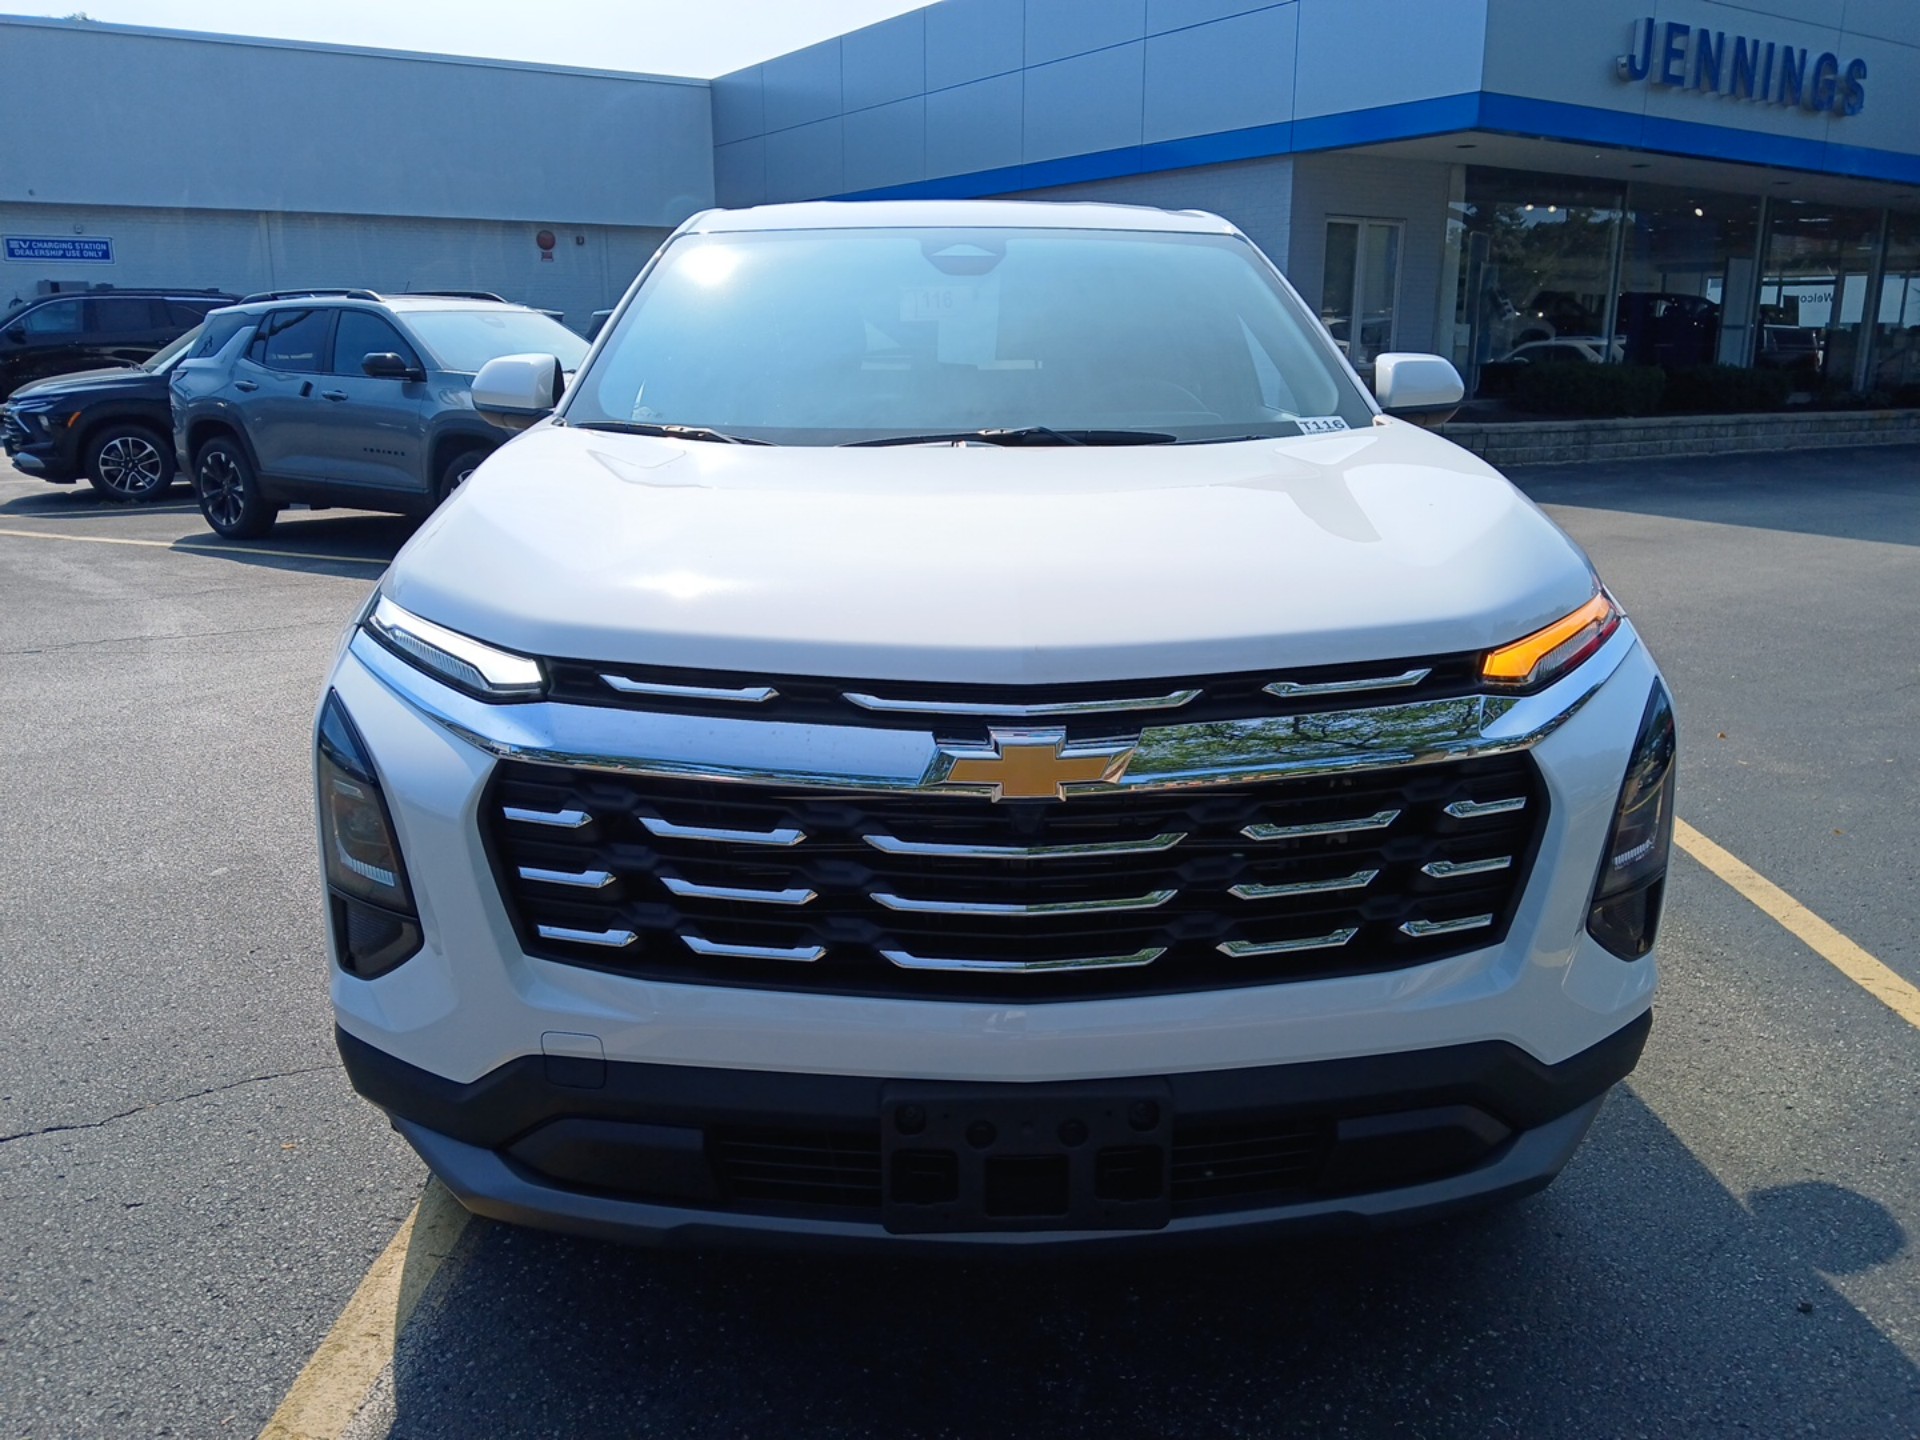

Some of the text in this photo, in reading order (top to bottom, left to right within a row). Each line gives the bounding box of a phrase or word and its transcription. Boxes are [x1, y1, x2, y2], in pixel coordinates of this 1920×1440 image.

[1615, 17, 1868, 117] JENNINGS
[31, 241, 73, 250] CHARGING
[75, 242, 107, 251] STATION
[14, 248, 103, 258] DEALERSHIP USE ONLY
[1299, 419, 1345, 431] T116
